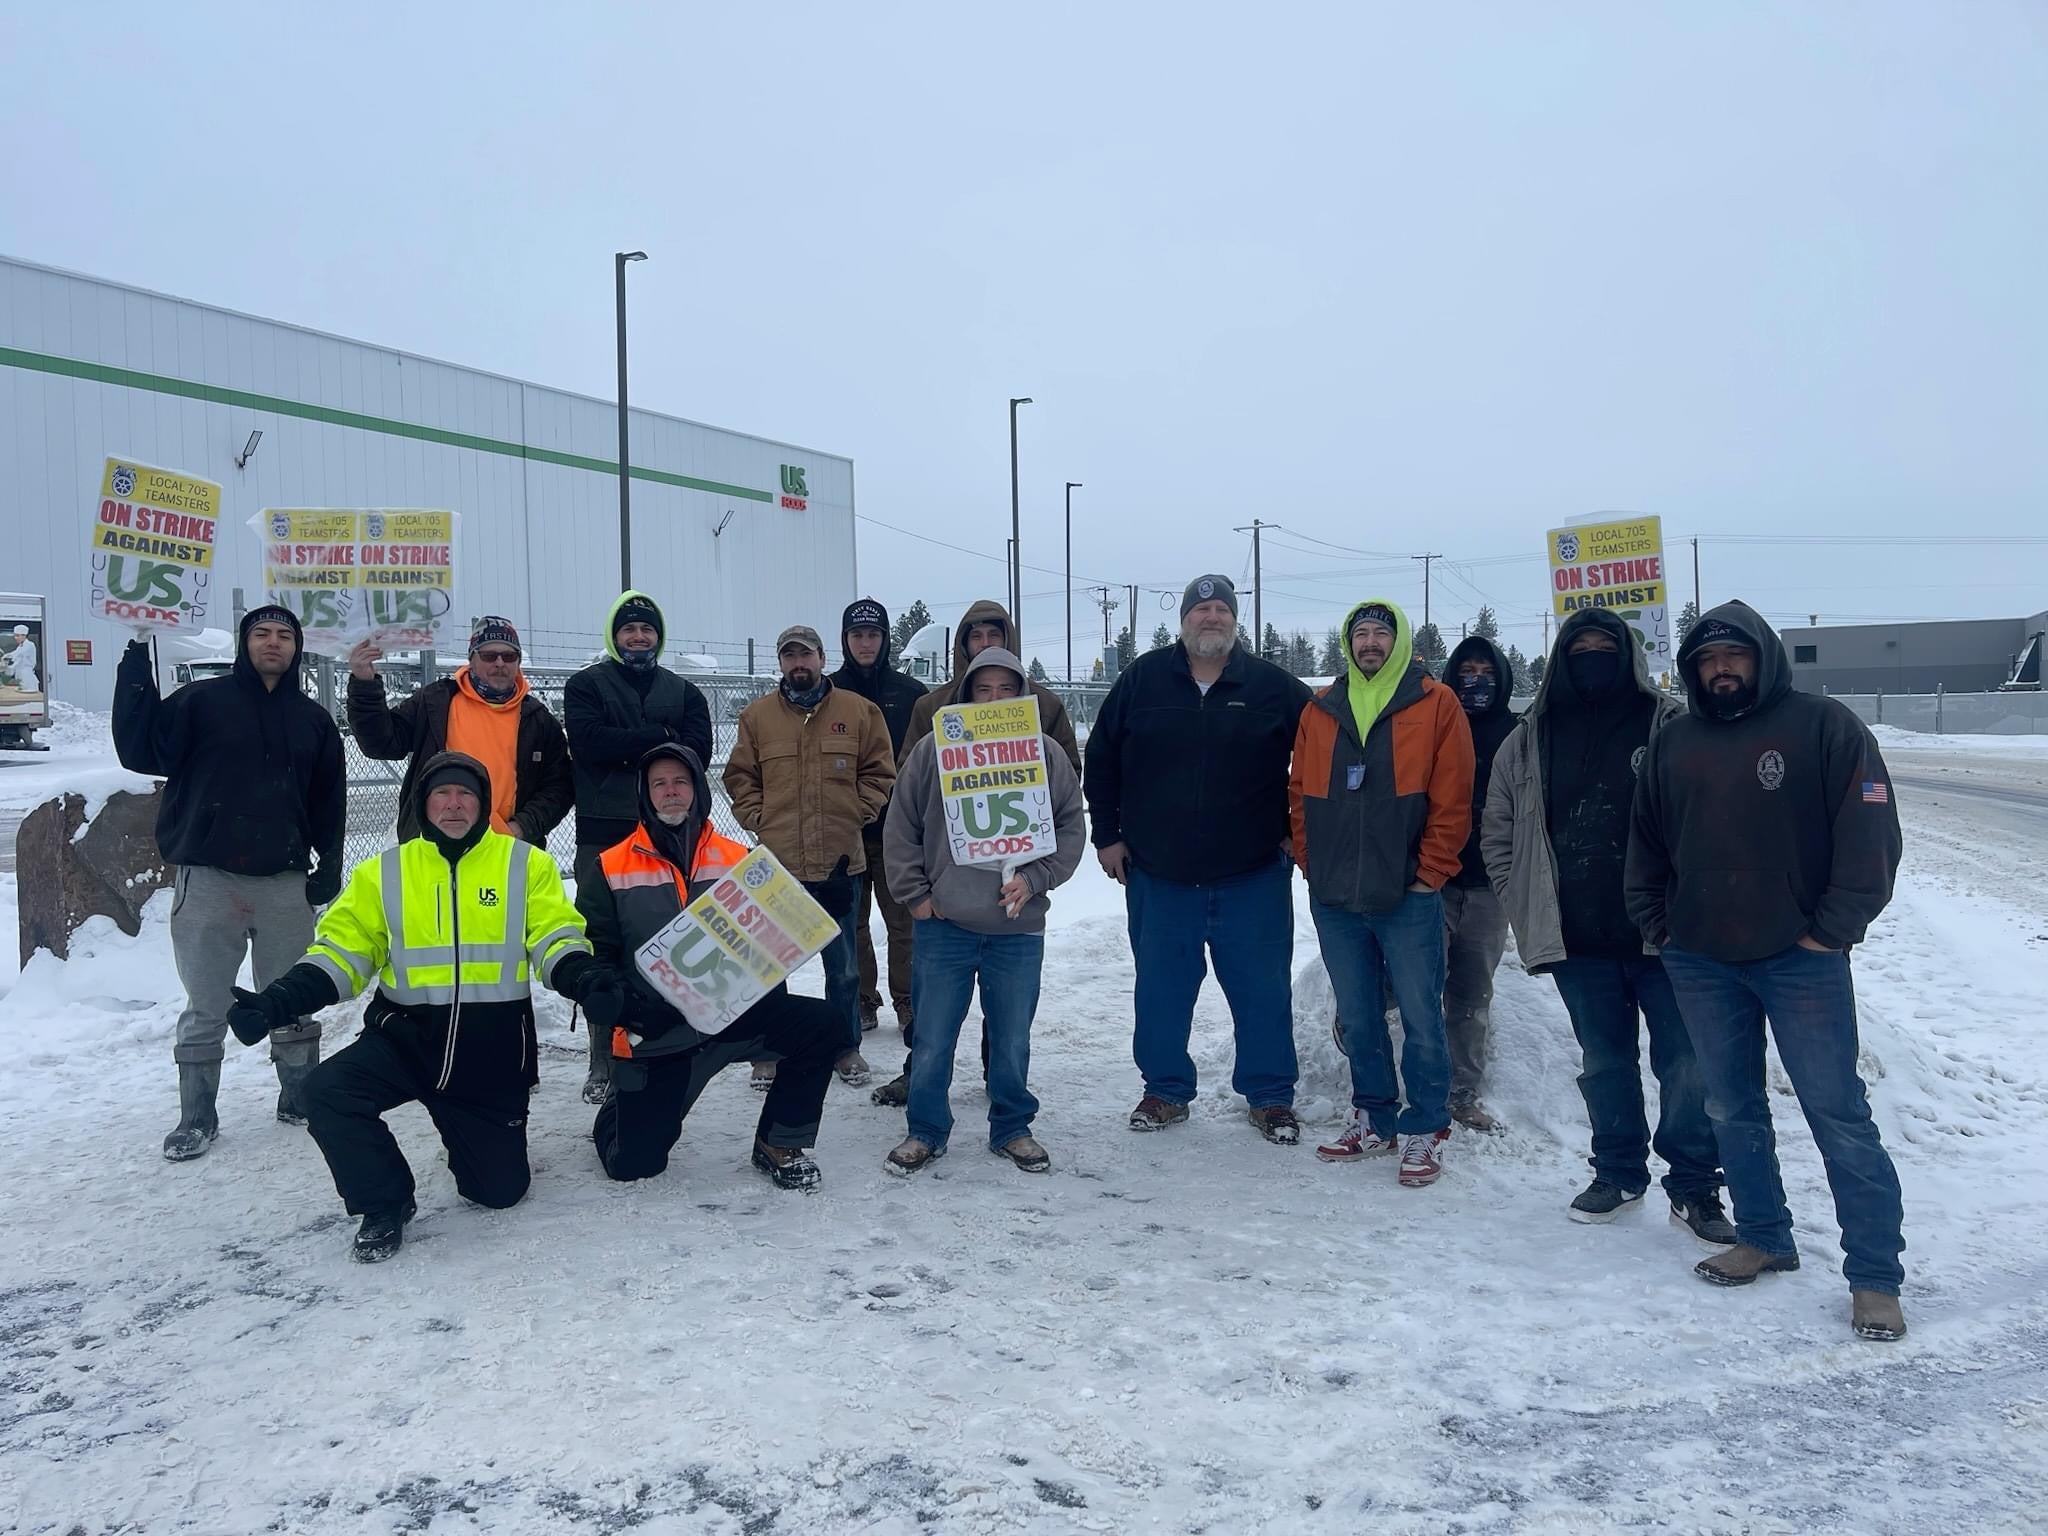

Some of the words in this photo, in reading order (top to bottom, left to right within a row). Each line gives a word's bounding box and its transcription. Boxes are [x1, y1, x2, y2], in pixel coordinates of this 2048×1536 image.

[150, 476, 185, 493] LOCAL
[188, 484, 208, 497] 705
[145, 489, 210, 511] TEAMSTERS
[100, 499, 132, 527] ON
[136, 507, 215, 544] STRIKE
[393, 529, 444, 538] TEAMSTERS
[1591, 530, 1624, 542] LOCAL
[1626, 525, 1646, 538] 705
[103, 531, 206, 562] AGAINST
[295, 545, 354, 566] STRIKE
[361, 545, 385, 565] ON
[388, 545, 450, 566] STRIKE
[1589, 540, 1651, 556] TEAMSTERS
[366, 571, 446, 584] AGAINST
[1555, 567, 1583, 591] ON
[1588, 557, 1661, 587] STRIKE
[1564, 587, 1657, 611] AGAINST
[105, 600, 180, 624] FOODS
[975, 709, 1004, 721] LOCAL
[1007, 706, 1024, 718] 705
[973, 721, 1030, 736] TEAMSTERS
[941, 747, 969, 771] ON
[973, 739, 1040, 767] STRIKE
[951, 768, 1038, 792] AGAINST
[968, 836, 1034, 859] FOODS
[713, 879, 749, 914] ON
